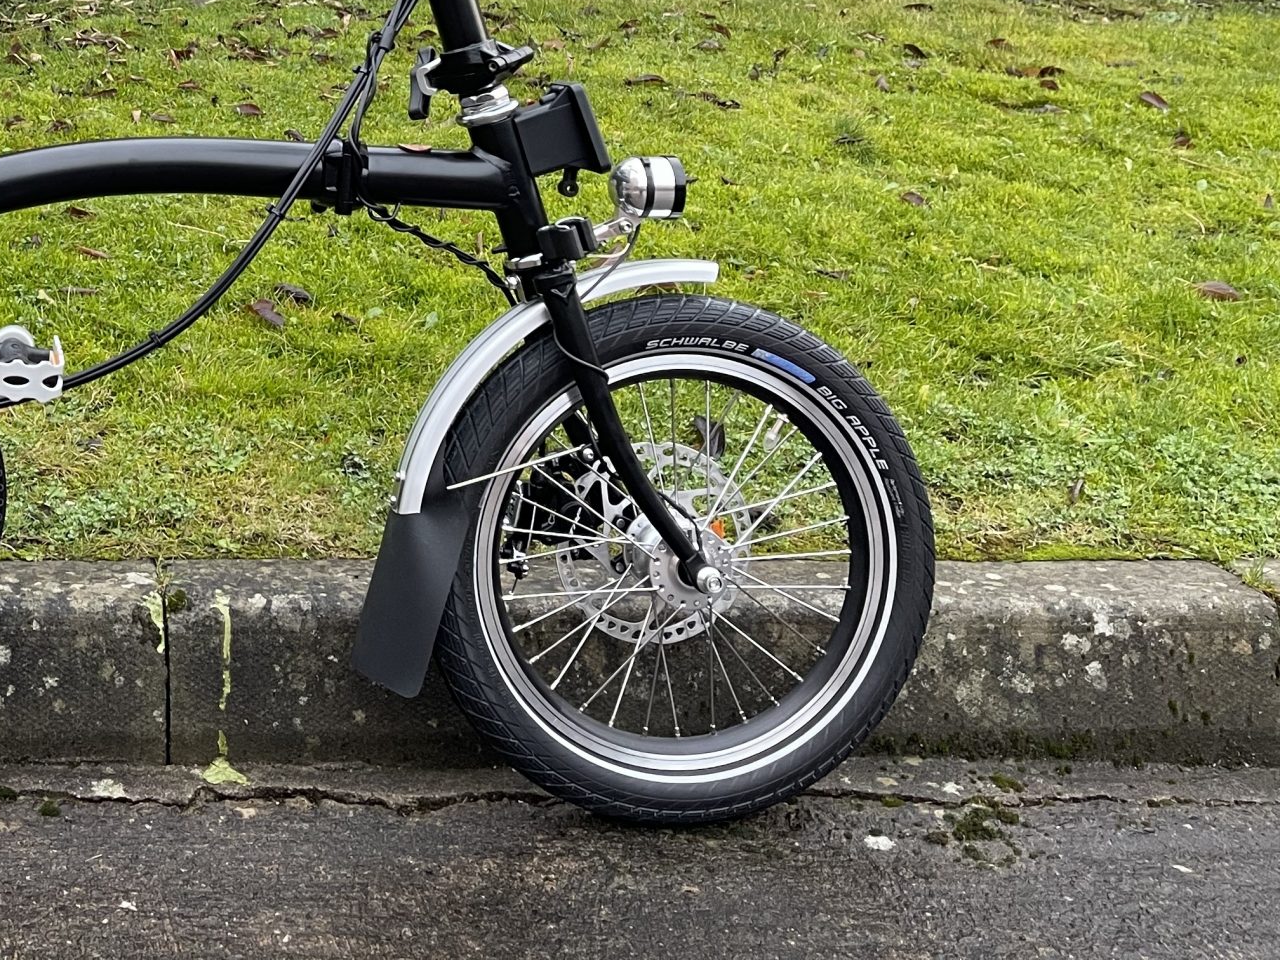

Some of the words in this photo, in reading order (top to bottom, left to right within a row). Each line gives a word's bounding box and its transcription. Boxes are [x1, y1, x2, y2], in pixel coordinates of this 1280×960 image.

[645, 336, 750, 353] SCHWALBE
[817, 385, 848, 410] BIG
[846, 415, 889, 471] APPLE
